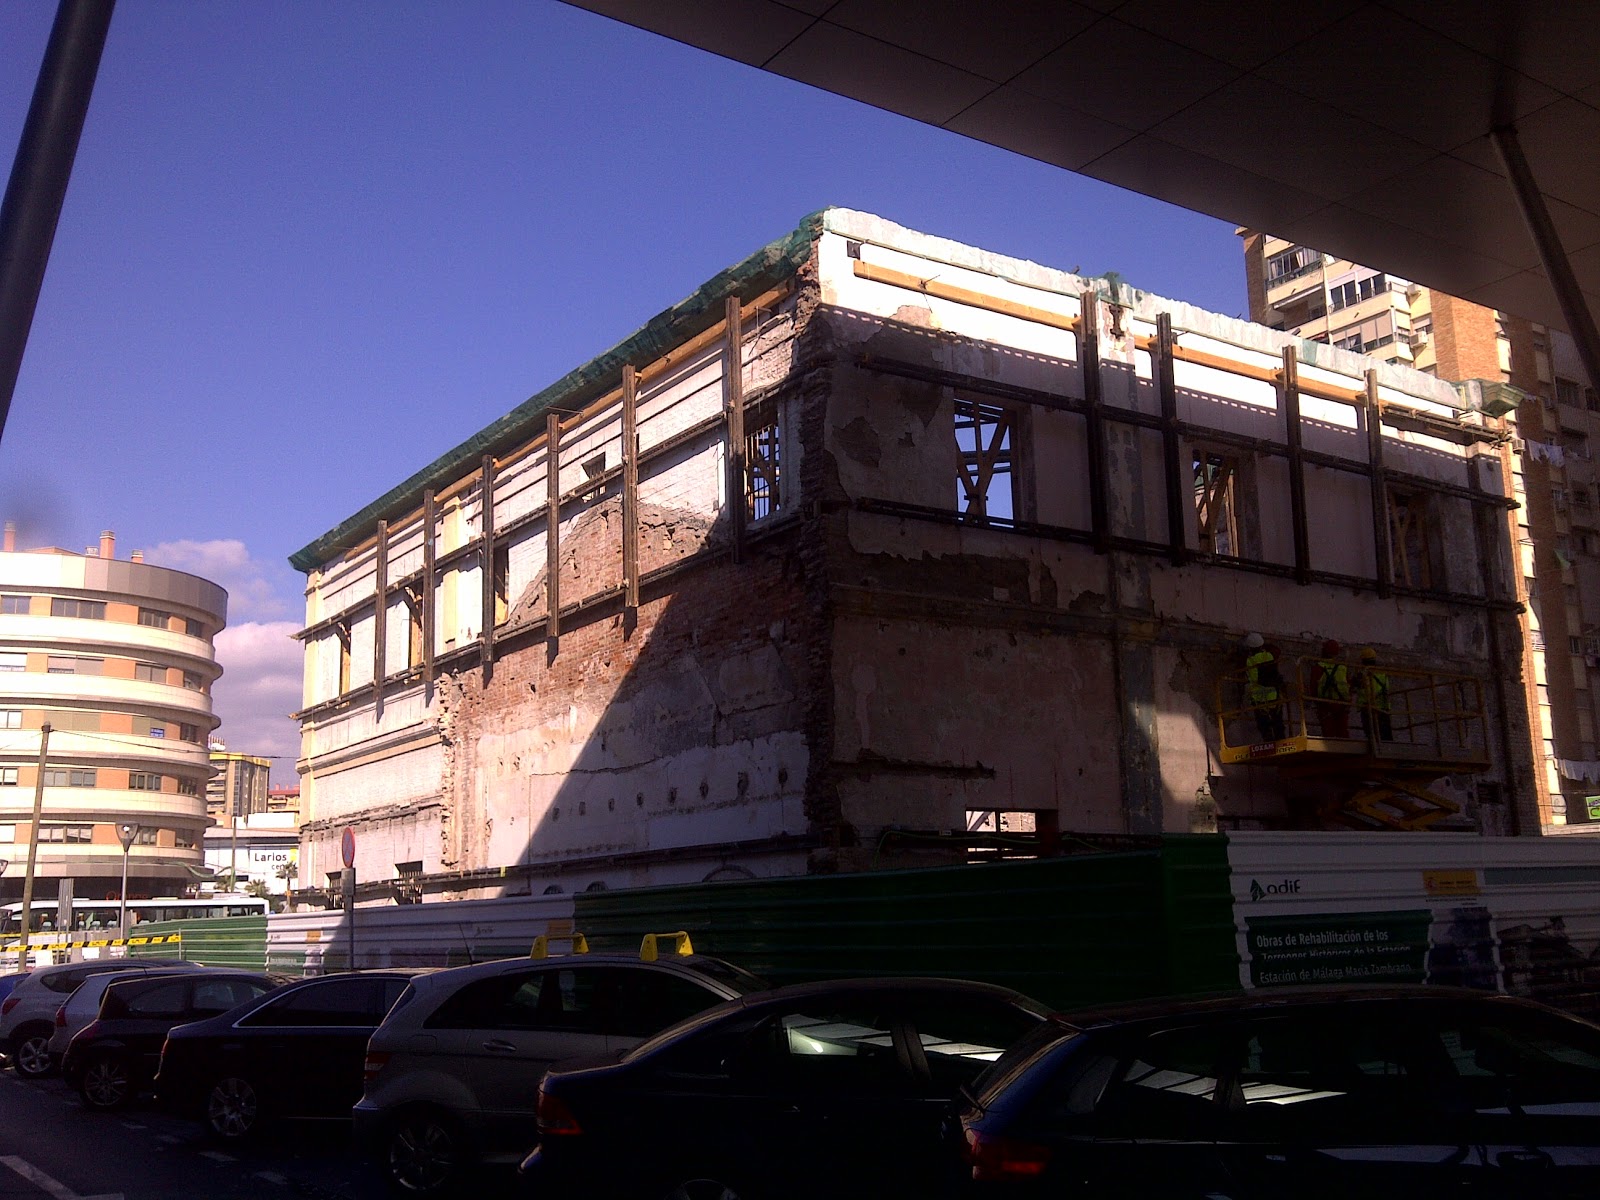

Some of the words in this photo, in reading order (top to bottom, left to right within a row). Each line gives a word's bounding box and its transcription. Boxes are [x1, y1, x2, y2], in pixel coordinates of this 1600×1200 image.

[1251, 743, 1275, 752] LOXAM
[255, 853, 287, 861] Larios
[1267, 880, 1300, 893] adif
[1257, 935, 1283, 948] Obras
[1286, 933, 1297, 945] de
[1300, 930, 1361, 945] Rehabilitación
[1364, 930, 1375, 941] de
[1377, 929, 1389, 941] los
[1260, 970, 1297, 984] Estación
[1300, 969, 1312, 981] de
[1313, 966, 1343, 979] Málaga
